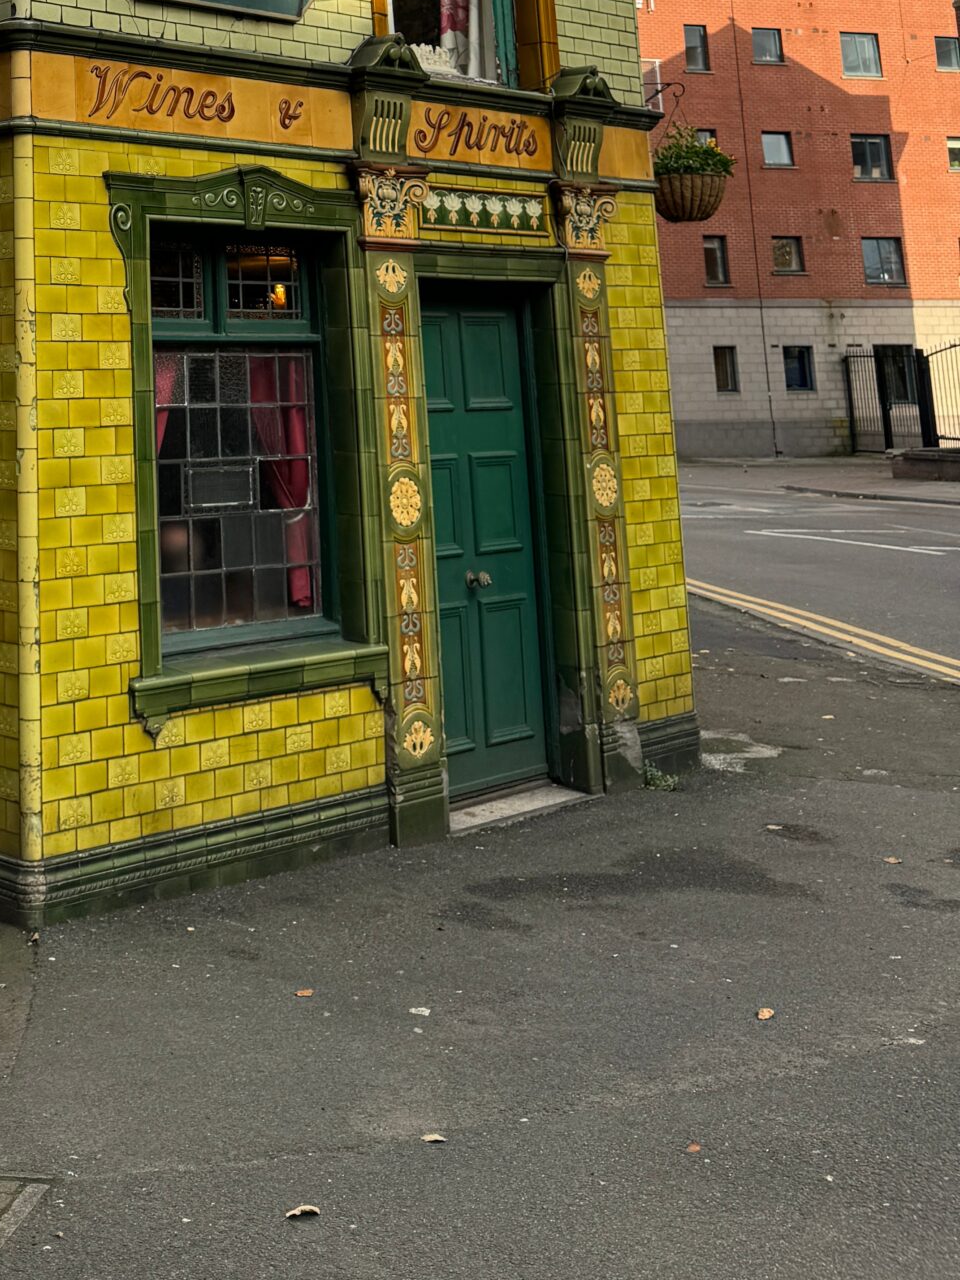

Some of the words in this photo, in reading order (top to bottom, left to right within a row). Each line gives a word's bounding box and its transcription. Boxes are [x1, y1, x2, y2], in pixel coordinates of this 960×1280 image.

[88, 63, 236, 123] Wines
[278, 98, 305, 129] &
[414, 107, 539, 158] Spirits
